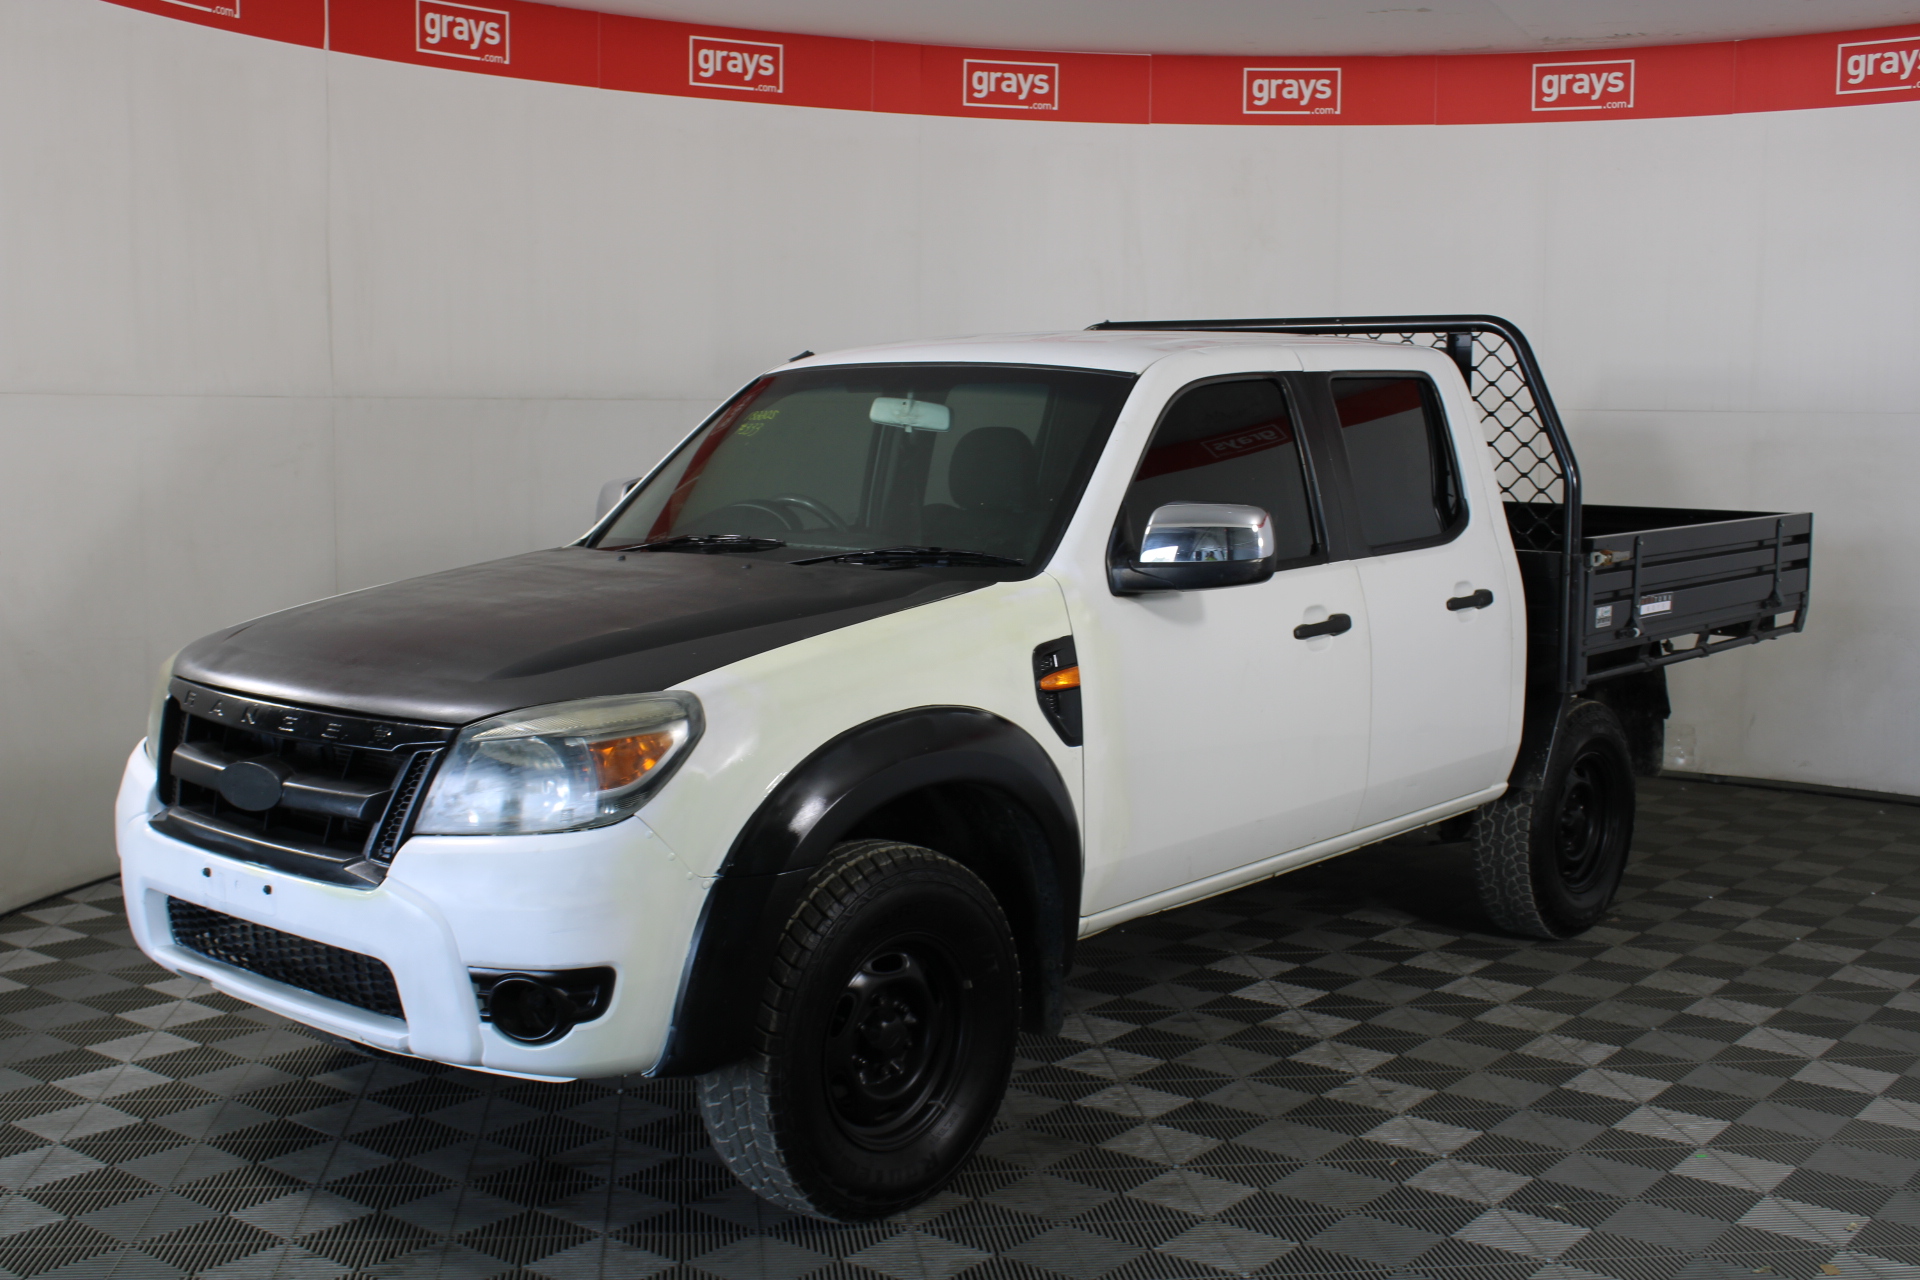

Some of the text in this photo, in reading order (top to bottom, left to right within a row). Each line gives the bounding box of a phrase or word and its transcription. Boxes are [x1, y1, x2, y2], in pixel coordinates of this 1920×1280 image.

[212, 6, 235, 17] .com
[424, 12, 501, 50] grays
[481, 54, 504, 63] .com
[697, 48, 775, 81] grays
[1847, 49, 1920, 84] gray
[754, 84, 777, 92] .com
[972, 70, 1050, 100] grays
[1252, 78, 1332, 106] grays
[1541, 71, 1625, 102] grays
[1311, 107, 1335, 115] .com
[1603, 101, 1627, 109] .com
